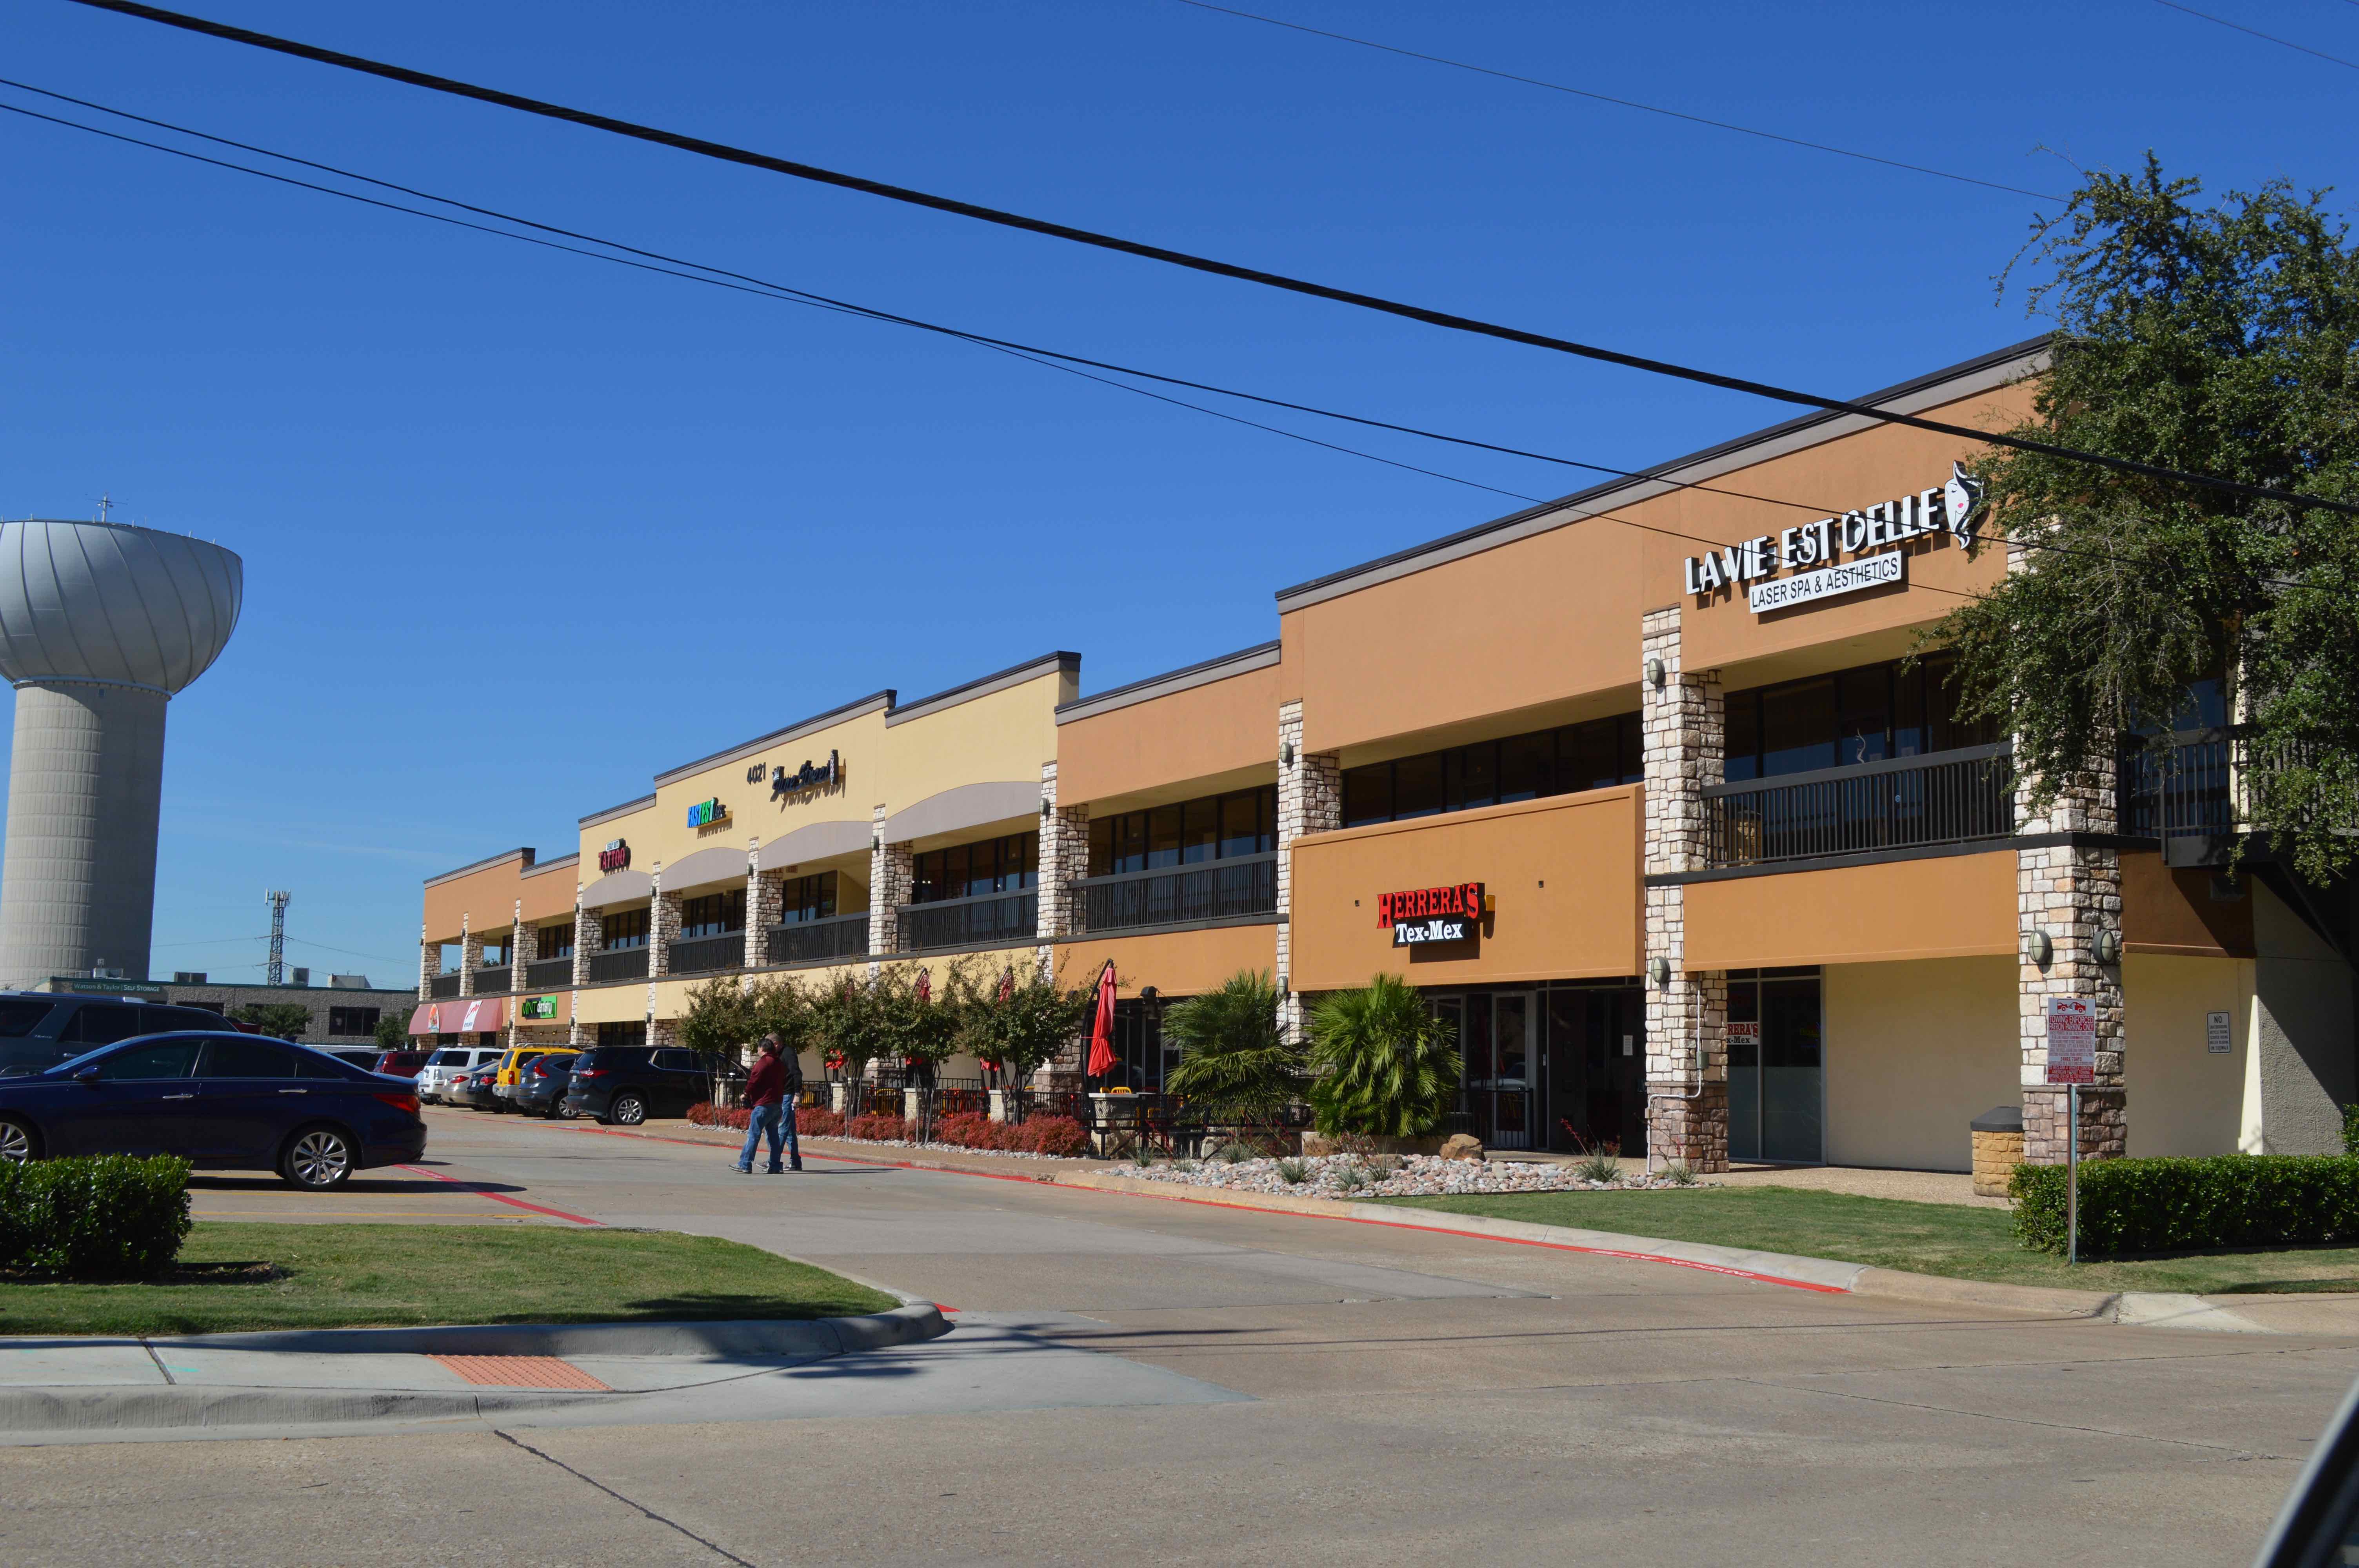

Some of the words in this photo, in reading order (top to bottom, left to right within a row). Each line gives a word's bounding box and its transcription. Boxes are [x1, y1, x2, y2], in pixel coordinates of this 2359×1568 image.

[1685, 551, 1721, 595] LA
[1724, 535, 1768, 583] VIE
[1782, 517, 1834, 569] EST
[1752, 584, 1787, 608] LASER
[1790, 578, 1811, 599] SPA
[1814, 575, 1822, 593] &
[1826, 557, 1898, 591] AESTHETICS
[746, 762, 766, 785] 4021
[687, 797, 716, 828] FASTEST
[598, 848, 626, 871] TATTOO
[1377, 882, 1479, 929] HERRERA'S
[1396, 920, 1463, 942] Tex-Mex
[1727, 1023, 1758, 1038] RERA'S
